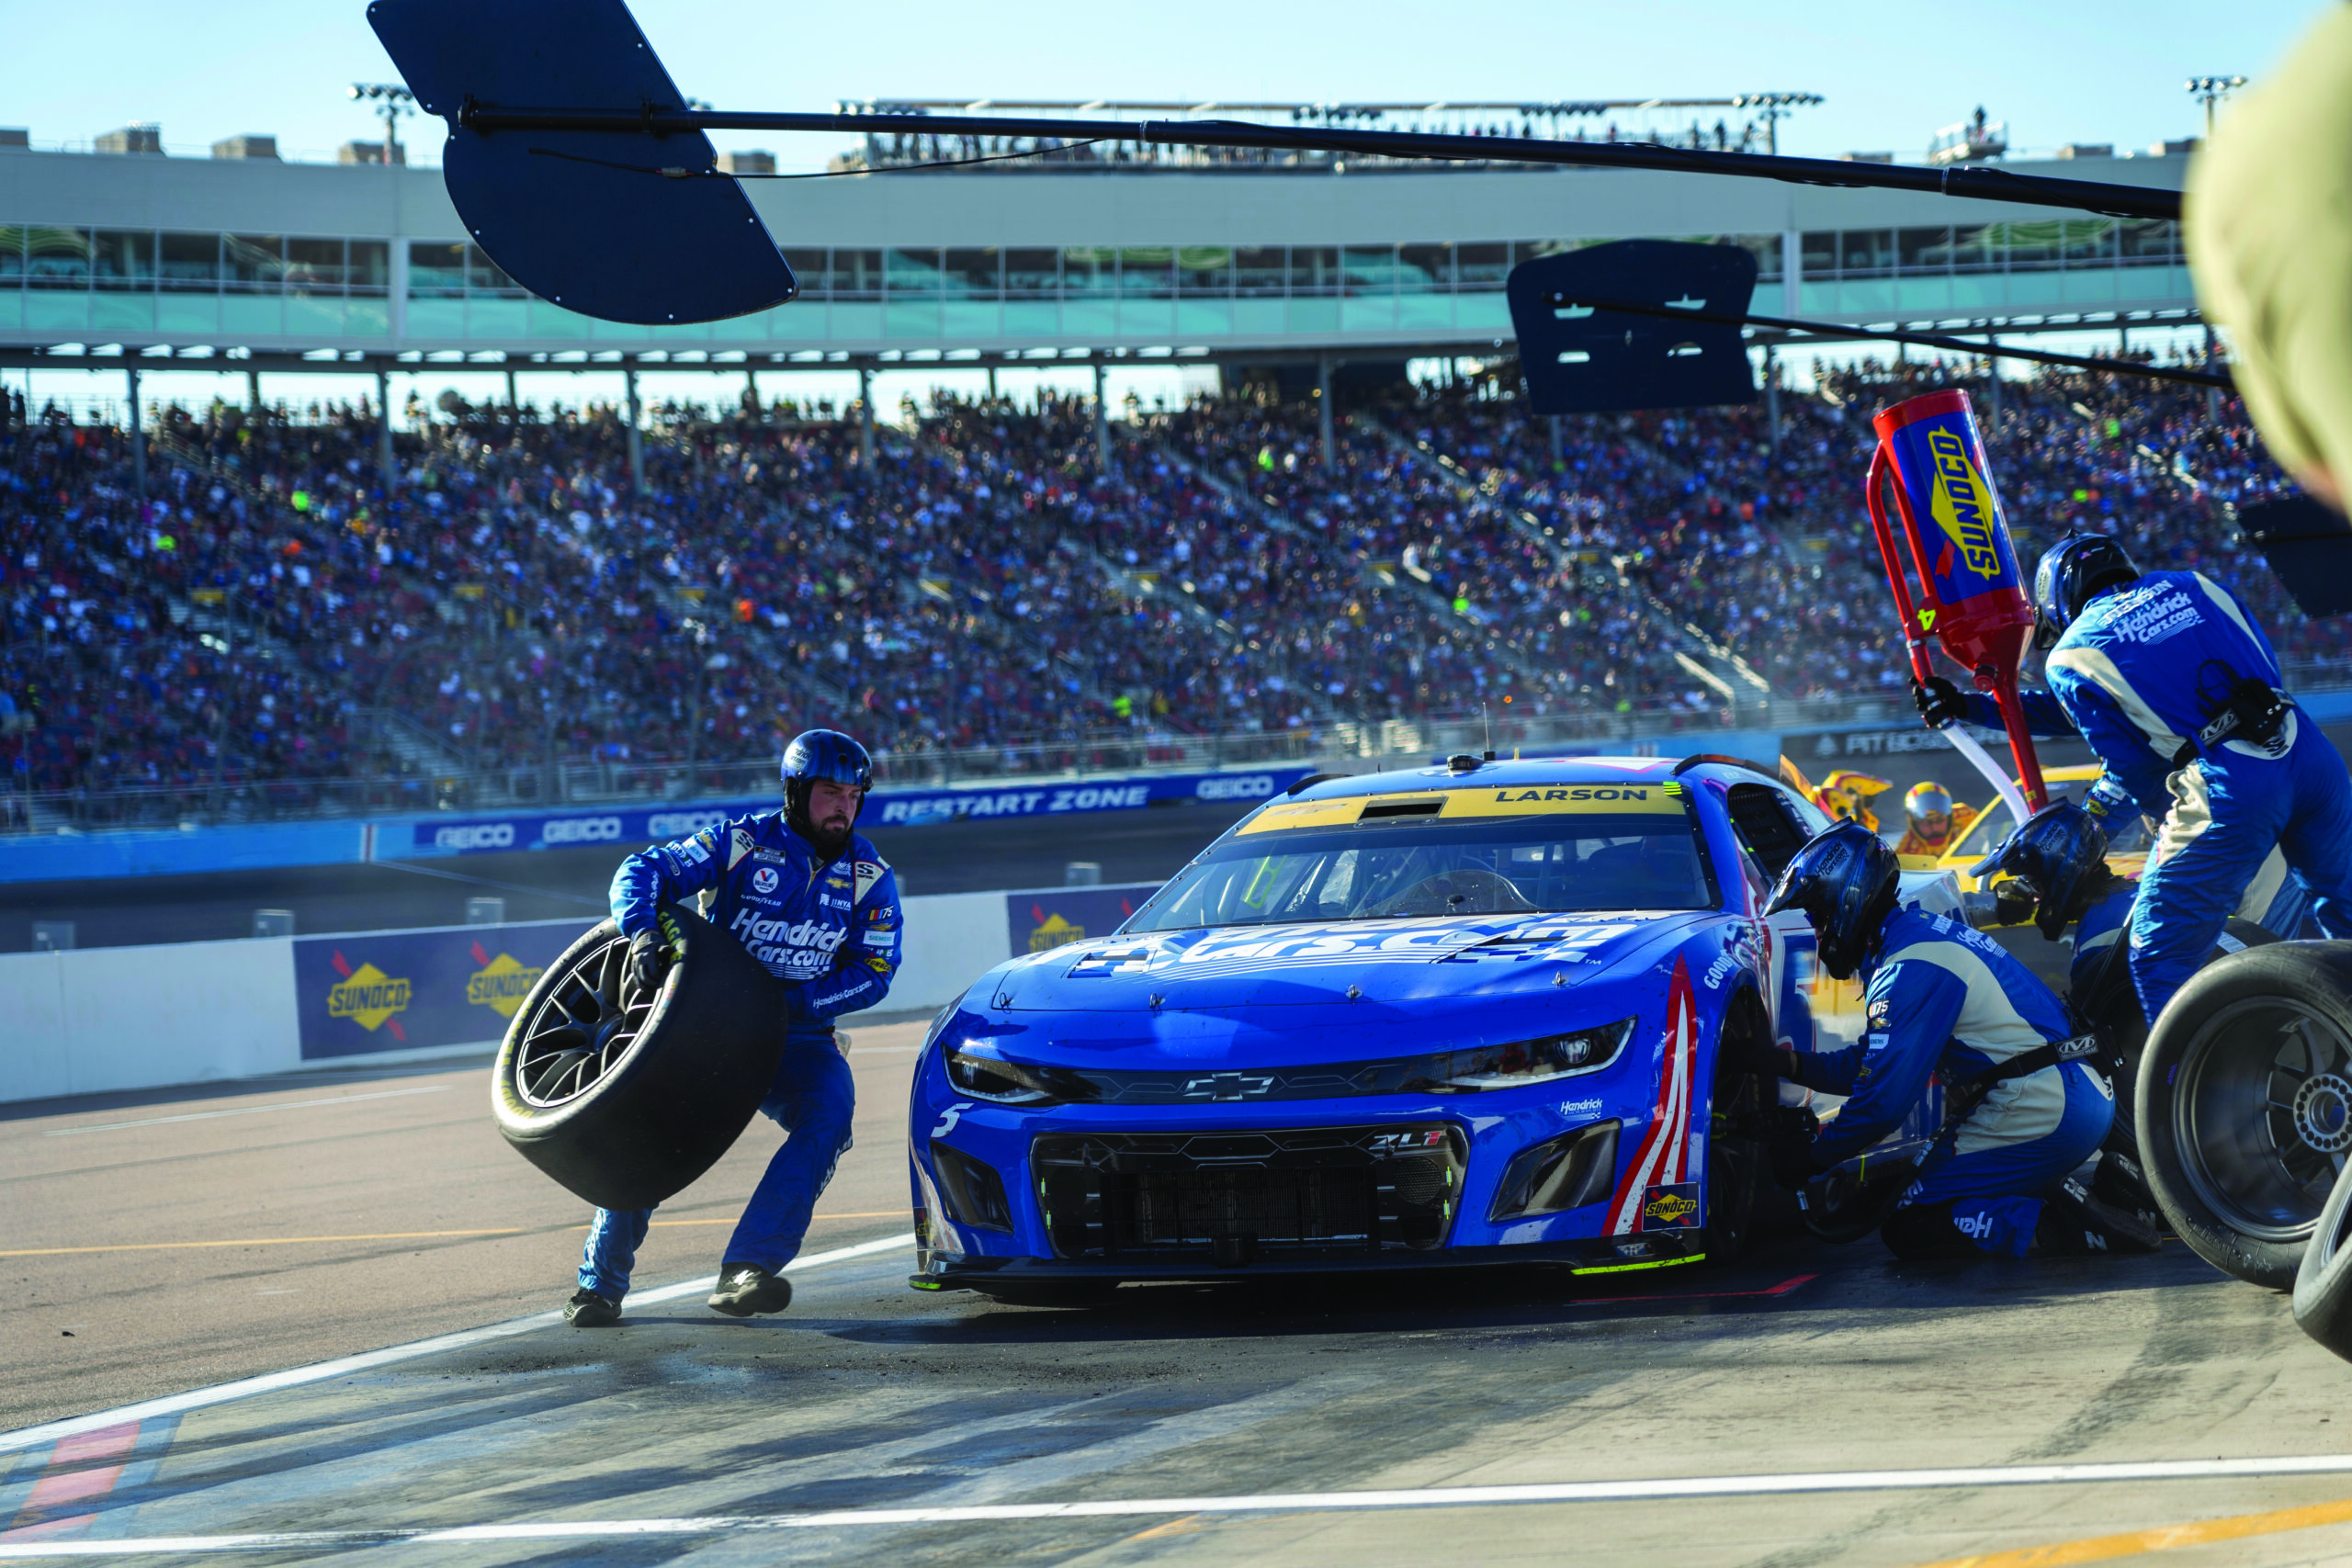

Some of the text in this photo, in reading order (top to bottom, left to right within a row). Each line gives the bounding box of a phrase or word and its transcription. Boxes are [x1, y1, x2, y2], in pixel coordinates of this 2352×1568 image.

[1932, 434, 1997, 571] SUNOCO
[1917, 608, 1937, 631] 4
[2113, 592, 2193, 643] Hendrick
[2138, 607, 2199, 643] Cars.com
[1197, 774, 1273, 800] GEICO
[1496, 788, 1647, 803] LARSON
[882, 785, 1150, 823] RESTART ZONE
[435, 824, 514, 849] GEICO
[543, 816, 622, 844] GEICO
[648, 810, 727, 838] GEICO
[1815, 841, 1843, 876] Hendrick
[1825, 849, 1849, 875] Cars.com
[882, 906, 894, 919] 75
[729, 908, 849, 953] Hendrick
[745, 939, 836, 967] Cars.com
[333, 983, 408, 1012] SUNOCO
[812, 979, 873, 1009] HendrickCars.com
[930, 1102, 975, 1138] 5
[1560, 1098, 1603, 1115] Hendrick
[1368, 1130, 1442, 1150] ZL1
[1647, 1201, 1695, 1216] SUNOCO
